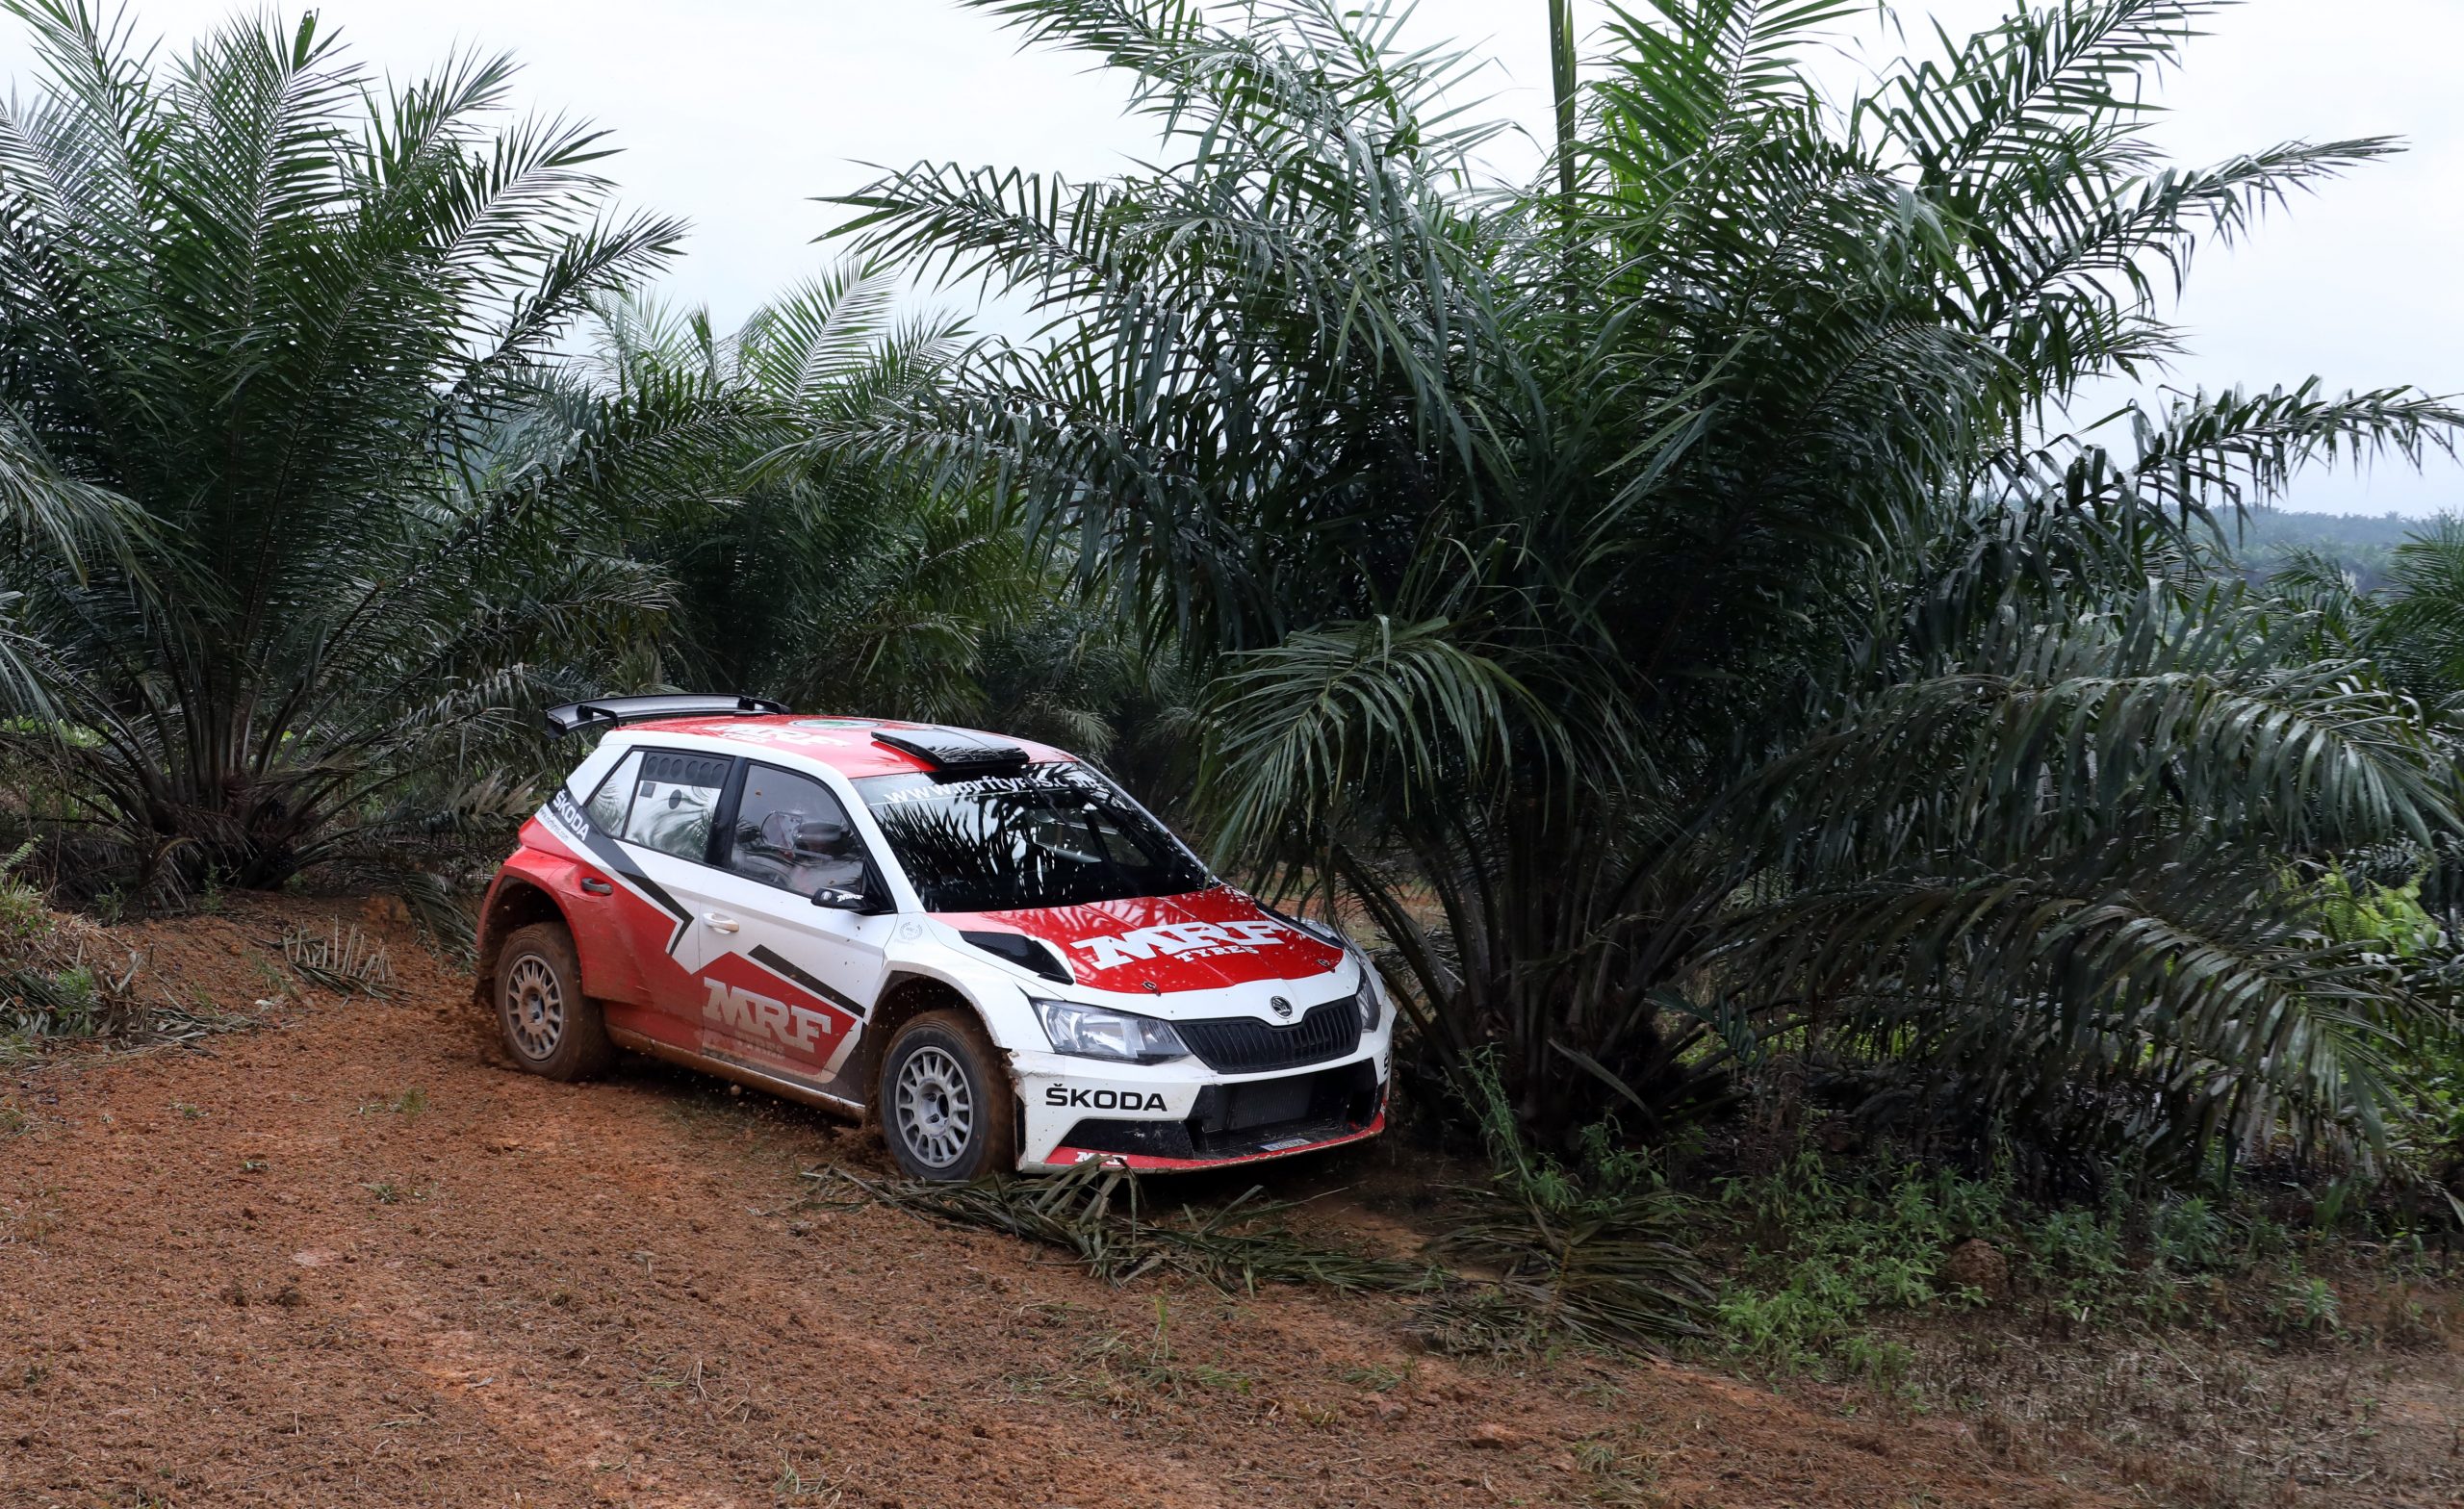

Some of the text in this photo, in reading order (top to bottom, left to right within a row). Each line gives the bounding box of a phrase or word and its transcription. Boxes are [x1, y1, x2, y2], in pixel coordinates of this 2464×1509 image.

[701, 724, 852, 747] MRF
[552, 789, 589, 841] ŠKODA
[1069, 921, 1286, 971] MRF
[1172, 945, 1260, 963] TYRES
[703, 976, 832, 1054] MRF
[1045, 1083, 1168, 1112] ŠKODA
[1075, 1151, 1128, 1165] MF
